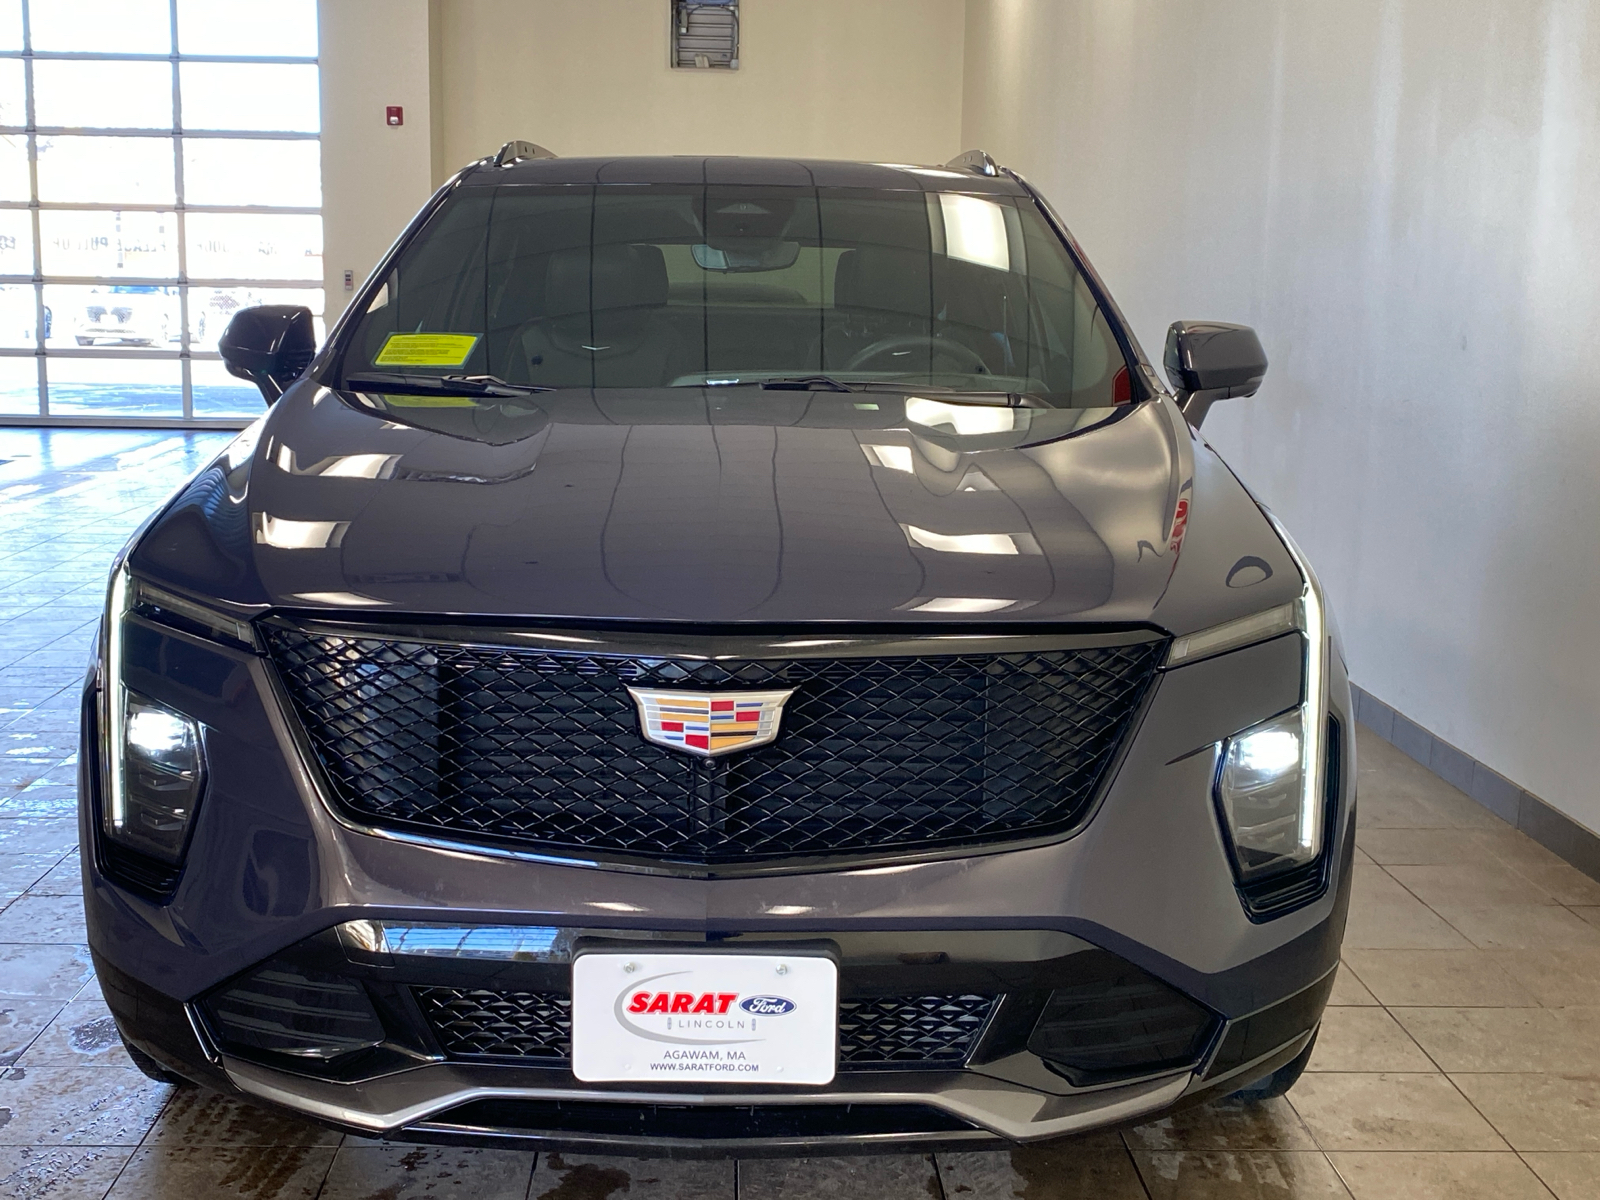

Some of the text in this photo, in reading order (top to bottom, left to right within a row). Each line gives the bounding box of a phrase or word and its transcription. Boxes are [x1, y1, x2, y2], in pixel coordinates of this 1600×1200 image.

[626, 991, 786, 1015] SARAT Ford
[678, 1020, 745, 1029] LINCOLN
[663, 1050, 746, 1061] AGAWAM, MA
[650, 1063, 759, 1072] WWW.SARATFORD.COM
